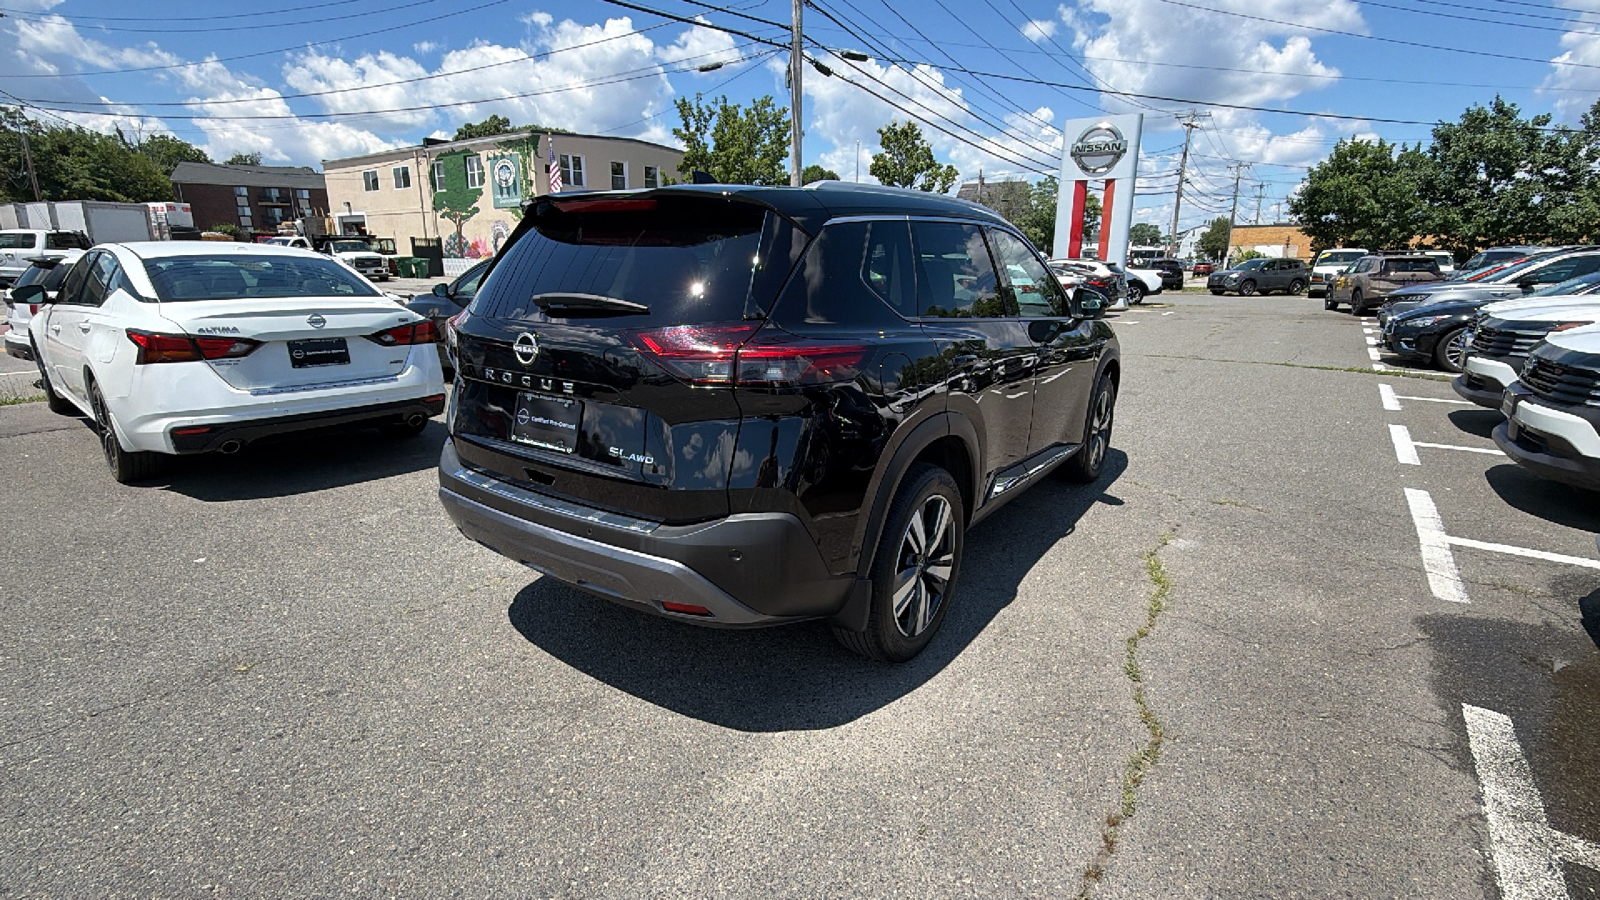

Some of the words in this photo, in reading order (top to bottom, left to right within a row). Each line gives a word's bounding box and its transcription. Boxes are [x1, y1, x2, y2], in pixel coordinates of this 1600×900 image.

[1074, 142, 1121, 153] NISSAN
[197, 326, 241, 334] ALTIMA
[484, 368, 574, 394] ROGUE
[608, 446, 628, 459] SL
[628, 453, 654, 464] AWD
